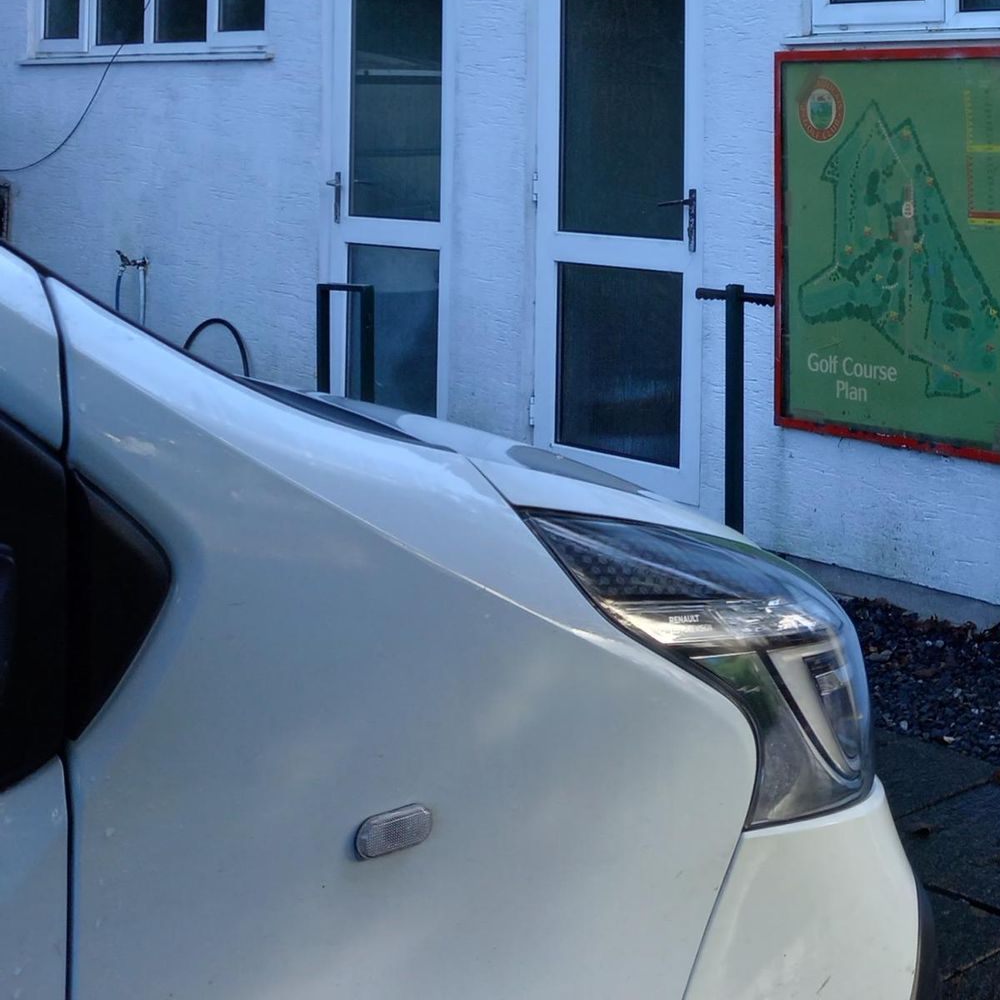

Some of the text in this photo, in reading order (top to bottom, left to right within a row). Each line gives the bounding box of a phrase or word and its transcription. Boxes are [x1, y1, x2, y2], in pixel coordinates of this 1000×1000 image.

[807, 352, 897, 382] Golf Course
[836, 380, 868, 402] Plan
[669, 614, 700, 623] RENAULT
